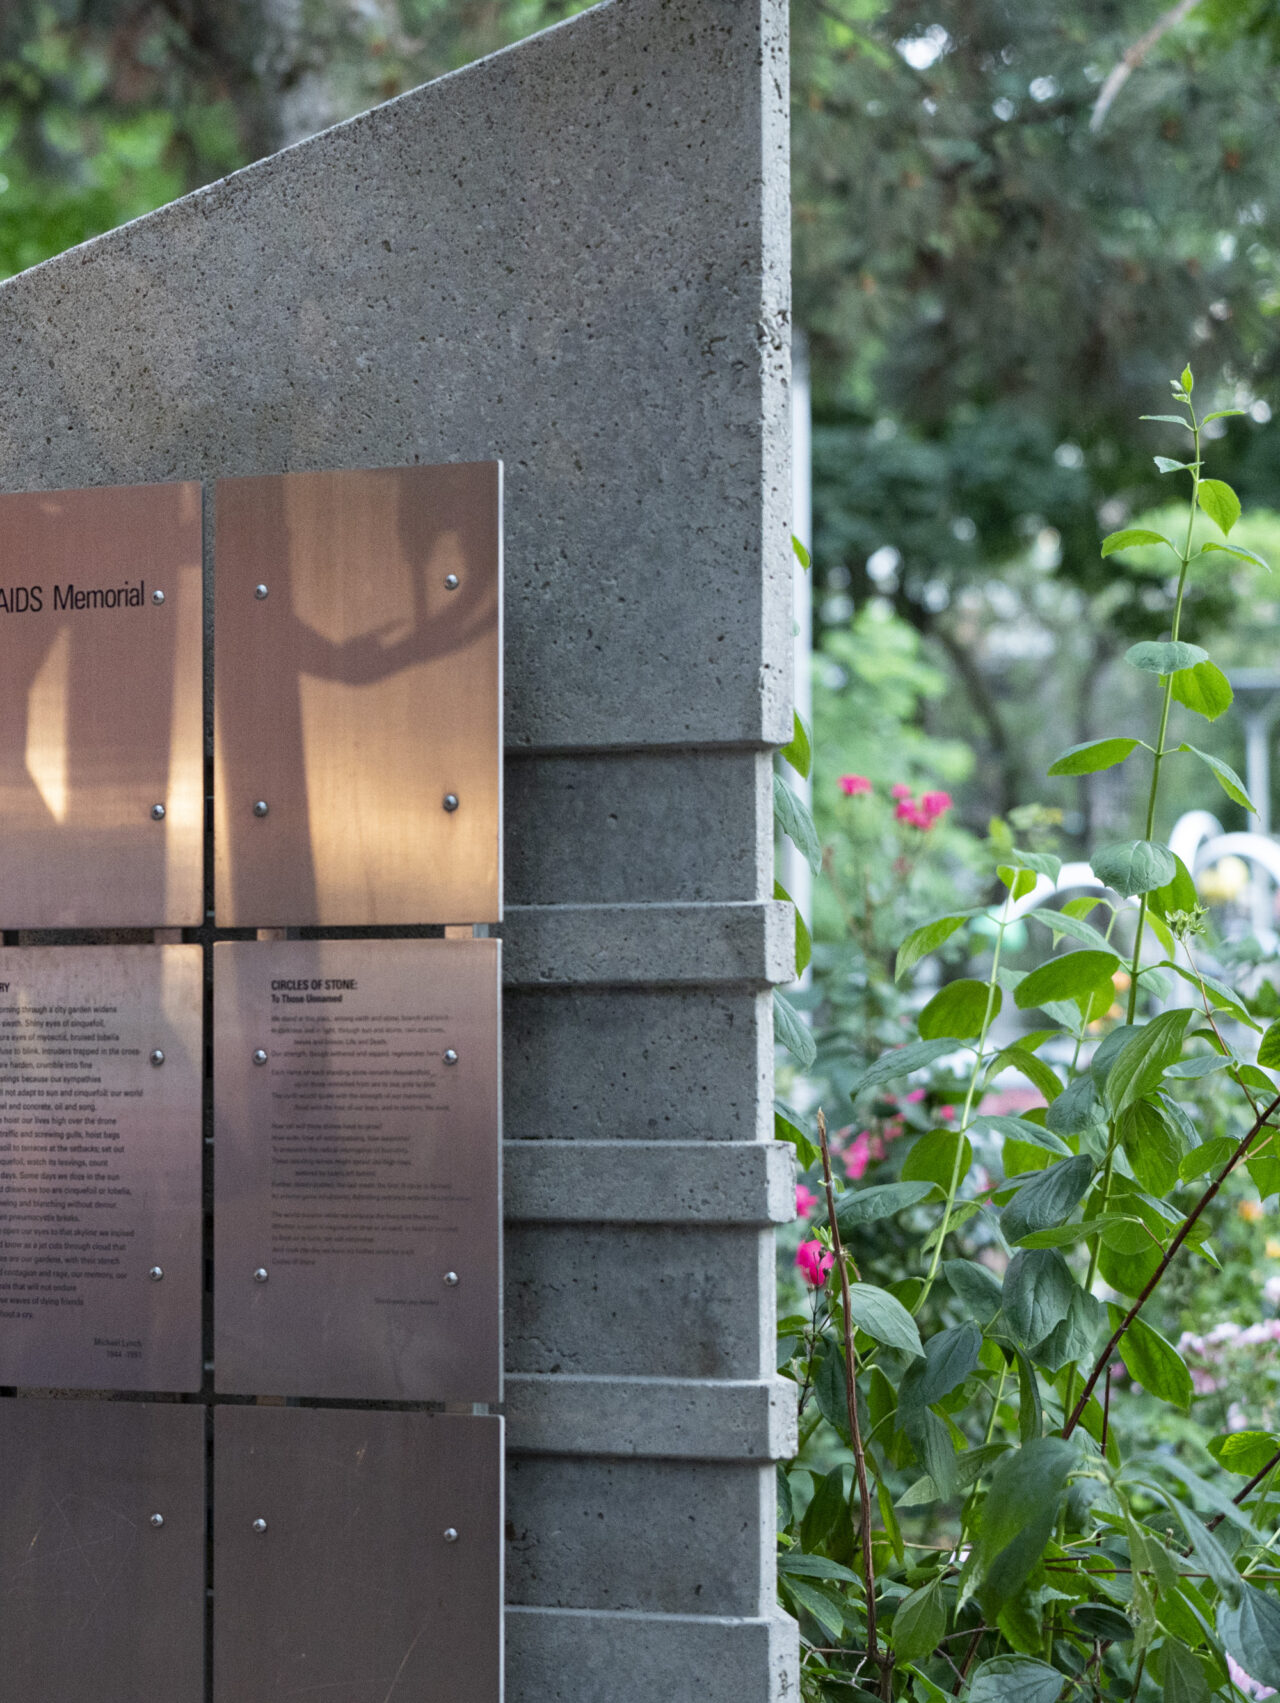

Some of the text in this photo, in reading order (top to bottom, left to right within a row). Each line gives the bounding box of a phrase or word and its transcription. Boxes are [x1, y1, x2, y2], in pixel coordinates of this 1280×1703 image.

[53, 580, 145, 610] Memorial
[271, 979, 357, 990] CIRCLES OF STONE:
[272, 994, 342, 1003] To Those Unnamed
